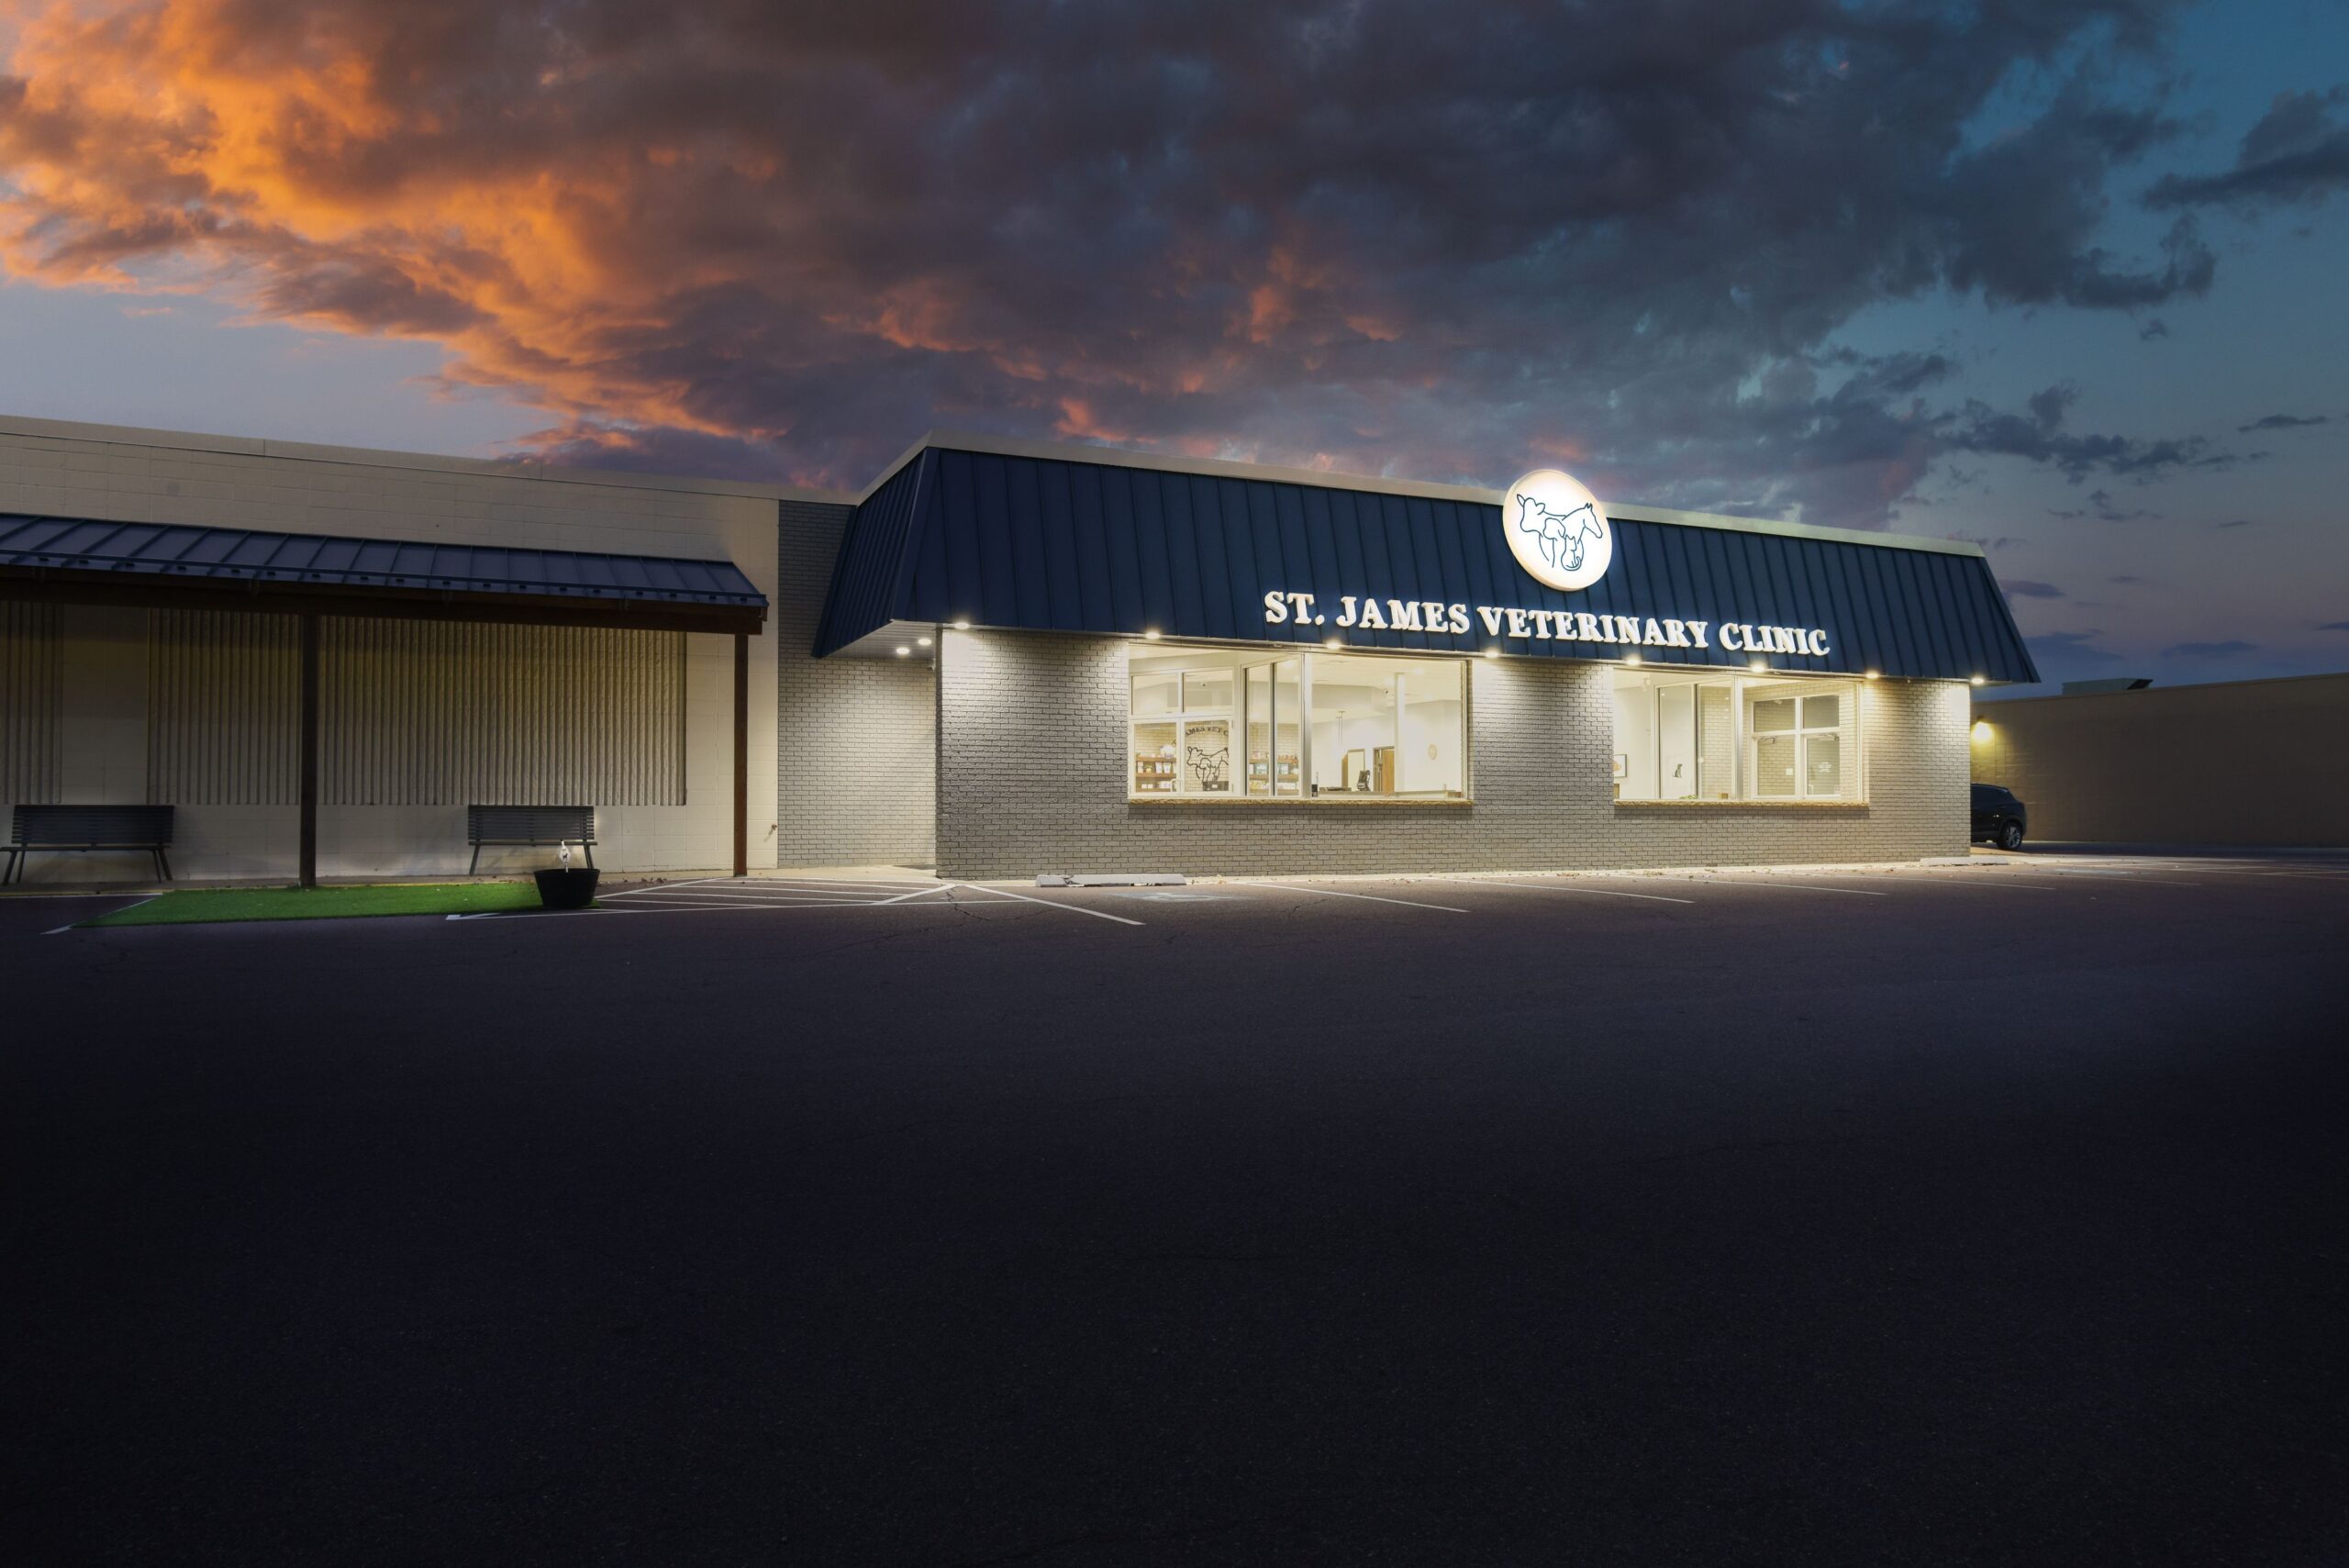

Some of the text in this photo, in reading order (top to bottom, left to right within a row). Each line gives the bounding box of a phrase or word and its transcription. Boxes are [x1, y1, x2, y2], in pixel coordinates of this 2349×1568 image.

[1264, 590, 1831, 657] ST. JAMES VETERINARY CLINIC
